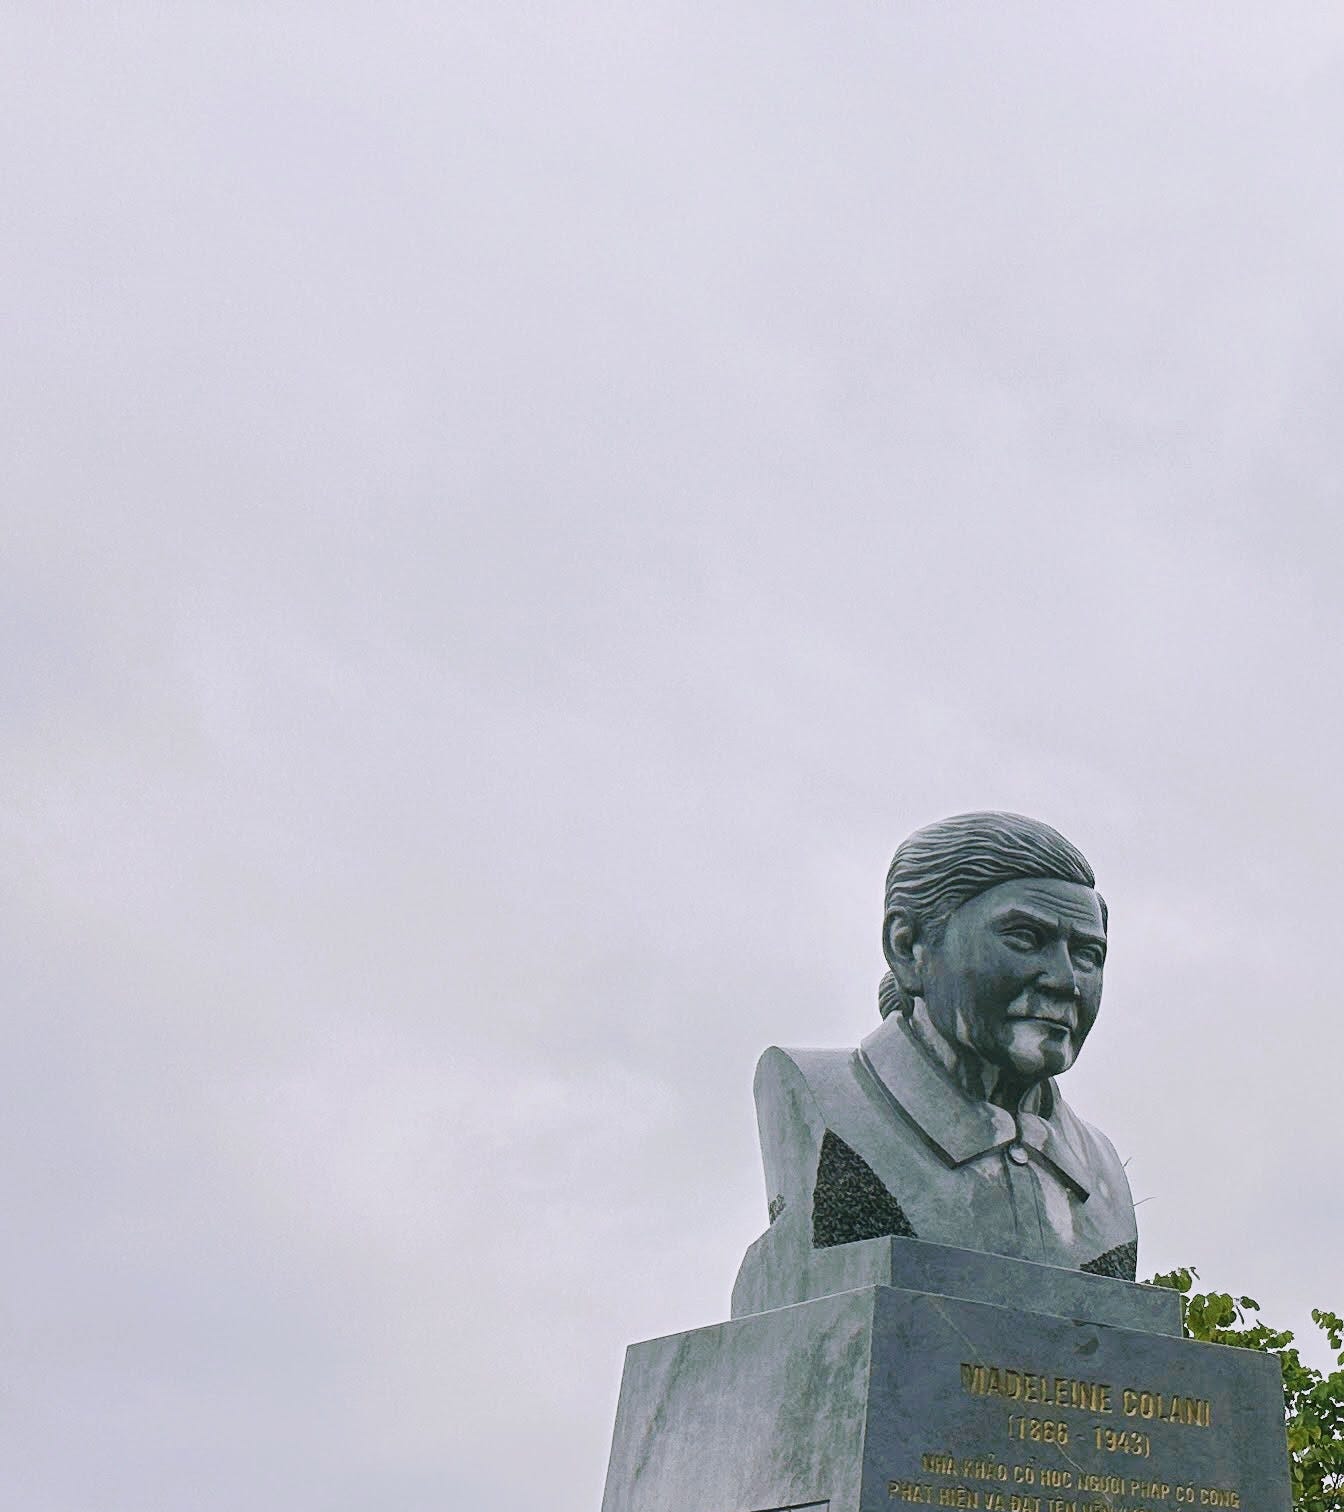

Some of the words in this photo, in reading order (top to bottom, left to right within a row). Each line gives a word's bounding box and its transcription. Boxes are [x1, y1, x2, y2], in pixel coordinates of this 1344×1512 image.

[960, 1362, 1113, 1414] MADELEINE
[1123, 1387, 1212, 1427] COLANI
[1008, 1414, 1069, 1446] (1866
[1094, 1426, 1150, 1458] 1943)
[888, 1477, 932, 1504] PHÁT
[939, 1486, 979, 1512] HIỆN
[984, 1489, 1006, 1512] VÀ
[1013, 1455, 1037, 1485] CỔ
[1176, 1481, 1195, 1504] CÓ
